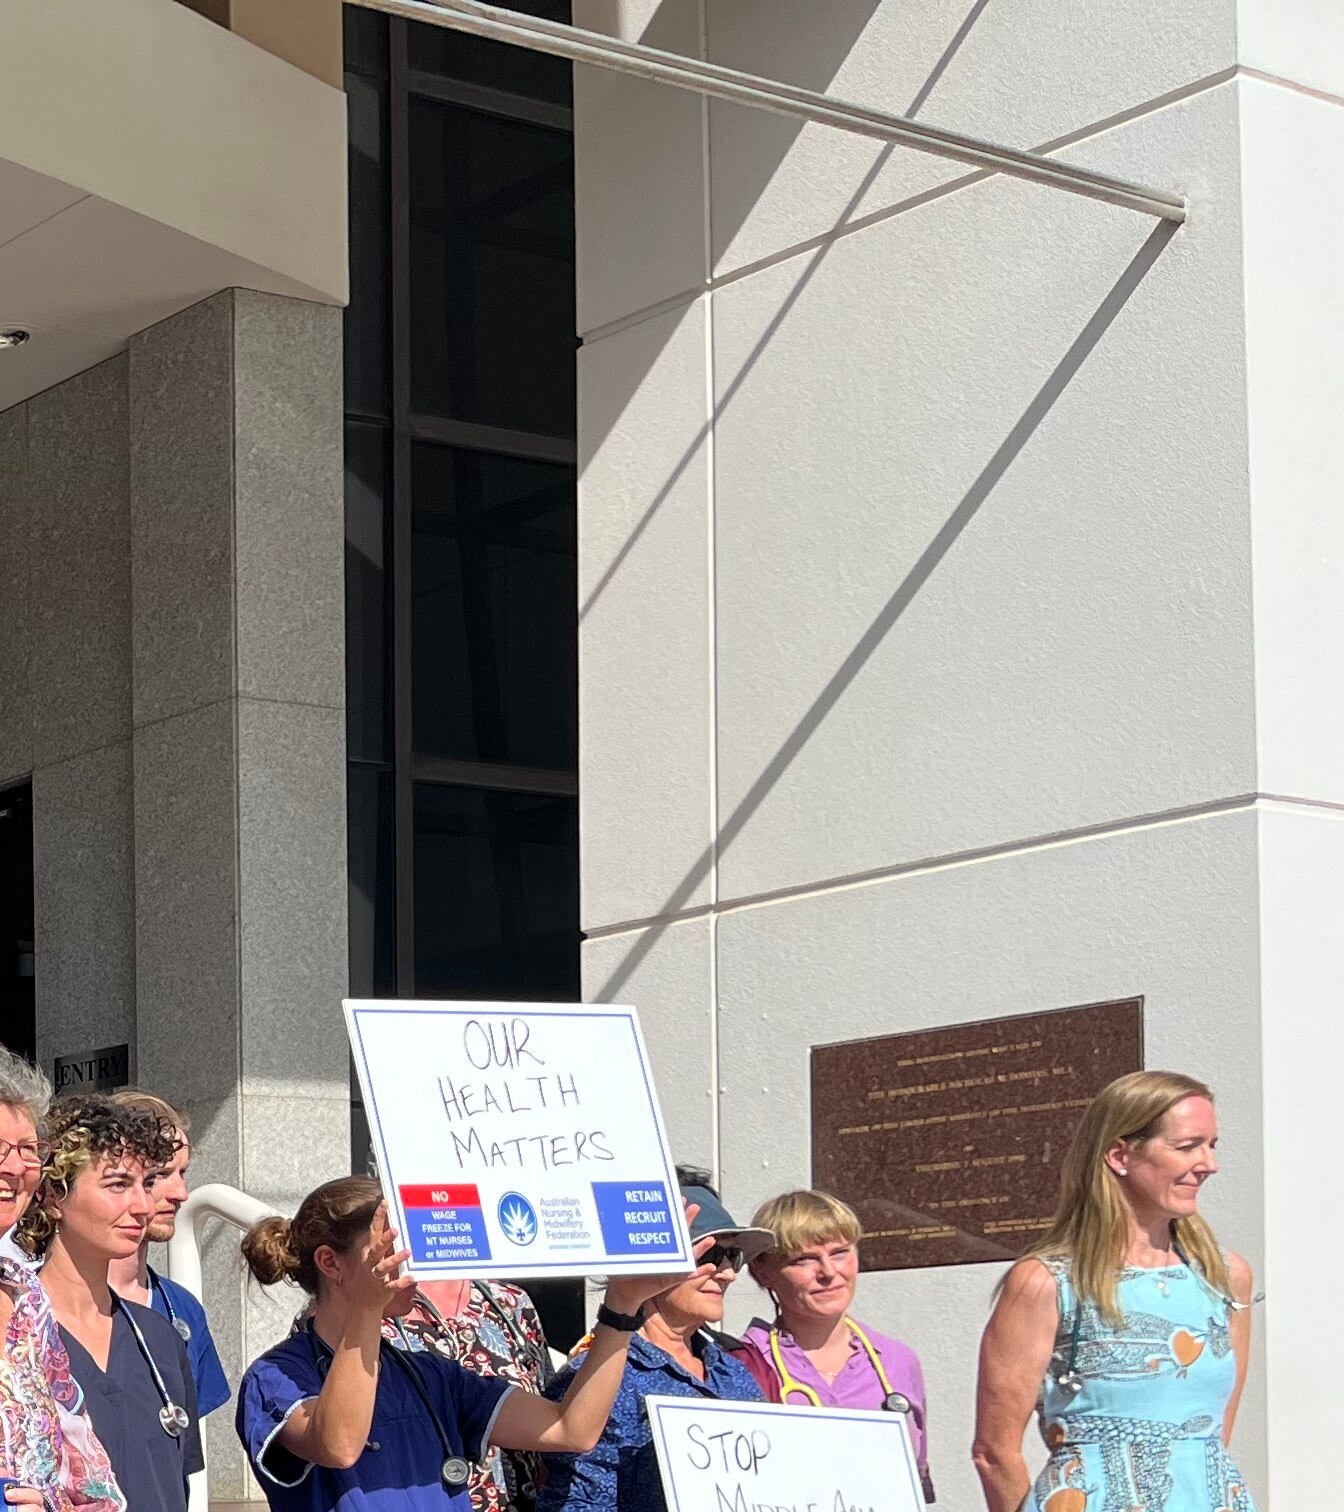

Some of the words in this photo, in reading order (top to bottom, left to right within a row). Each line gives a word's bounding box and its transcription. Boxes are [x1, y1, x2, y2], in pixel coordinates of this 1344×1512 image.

[464, 1017, 545, 1070] OUR
[60, 1055, 123, 1086] ENTRY
[438, 1073, 580, 1122] HEALTH
[450, 1127, 614, 1170] MATTERS
[431, 1191, 449, 1203] NO
[624, 1190, 663, 1202] RETAIN
[432, 1210, 457, 1220] WAGE
[624, 1211, 667, 1224] RECRUIT
[422, 1223, 454, 1233] FREEZE
[454, 1223, 472, 1232] FOR
[425, 1236, 439, 1246] NT
[439, 1236, 473, 1246] NURSES
[628, 1232, 671, 1245] RESPECT
[436, 1248, 479, 1259] MIDWIVES
[687, 1423, 771, 1476] STOP
